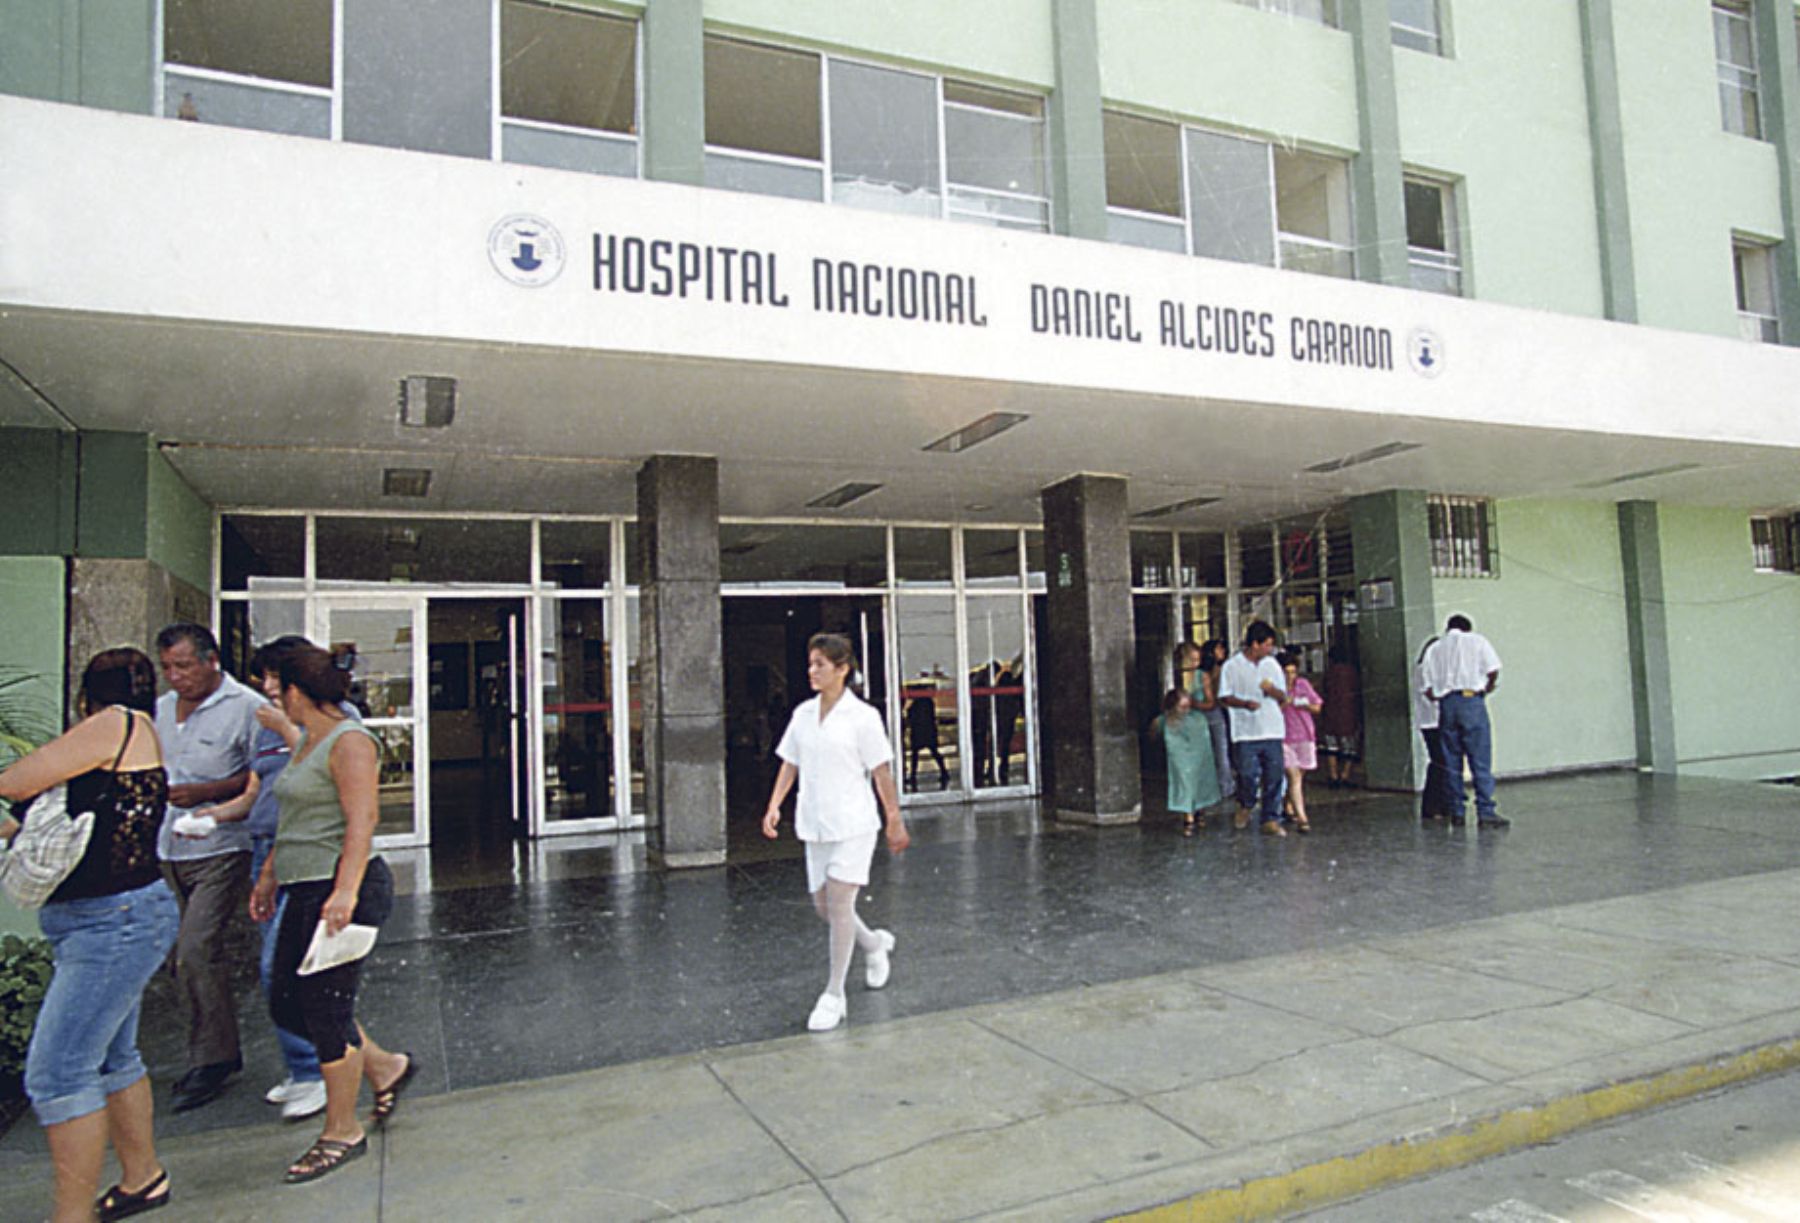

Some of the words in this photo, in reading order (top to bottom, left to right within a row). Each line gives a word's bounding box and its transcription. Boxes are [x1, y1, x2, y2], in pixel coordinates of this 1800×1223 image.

[593, 233, 789, 307] HOSPITAL
[813, 258, 987, 326] NACIONAL
[1031, 284, 1142, 343] DANIEL
[1160, 301, 1275, 358] ALCIDES
[1290, 317, 1394, 371] CARRION
